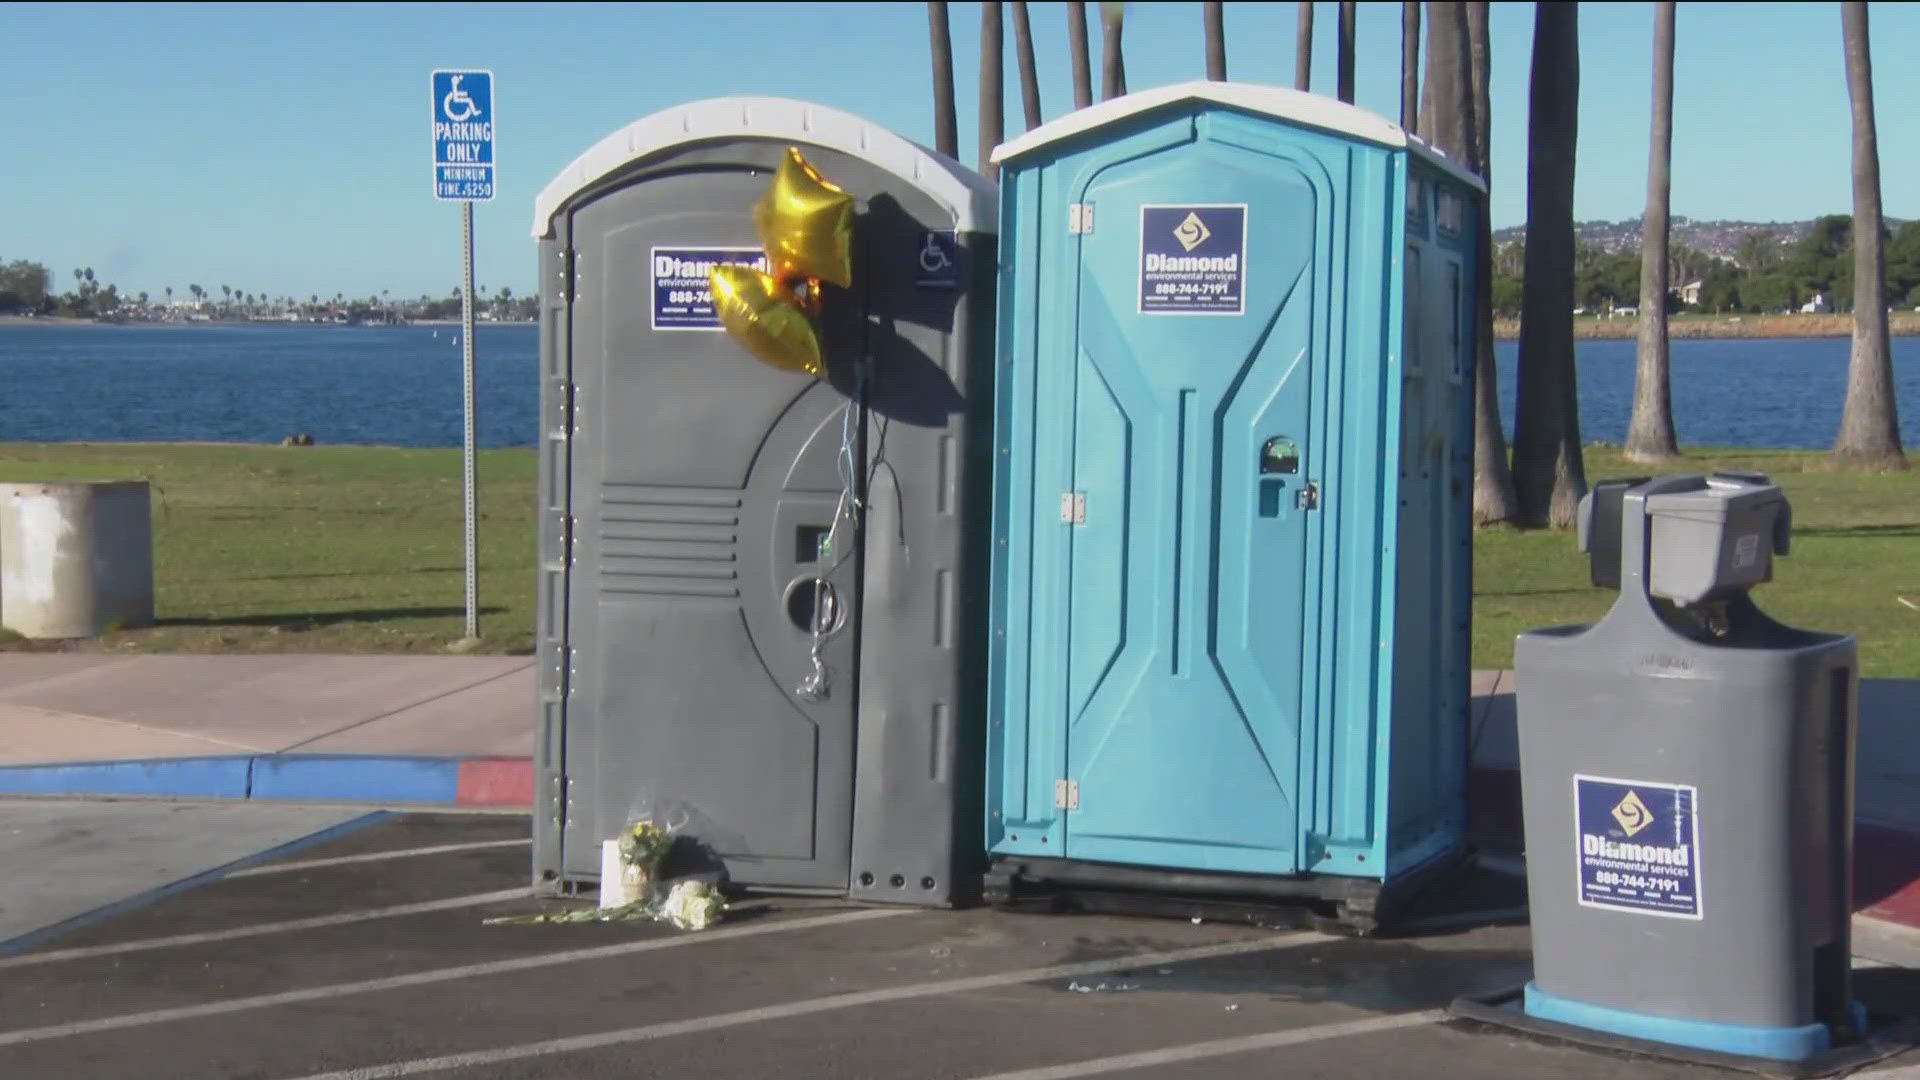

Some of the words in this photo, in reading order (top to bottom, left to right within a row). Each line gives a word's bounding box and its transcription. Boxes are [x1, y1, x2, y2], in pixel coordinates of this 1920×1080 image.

[436, 121, 491, 142] PARKING
[447, 142, 480, 162] ONLY
[443, 168, 486, 181] MINIMUM
[438, 182, 460, 196] FINE
[1145, 253, 1238, 272] Diamond
[1145, 272, 1203, 280] environmental
[1205, 273, 1237, 281] services
[1155, 283, 1228, 295] 888-744-7191
[1583, 833, 1689, 867] Diamond
[1584, 856, 1649, 873] environmental
[1650, 864, 1689, 877] services
[1596, 870, 1680, 893] 888-744-7191
